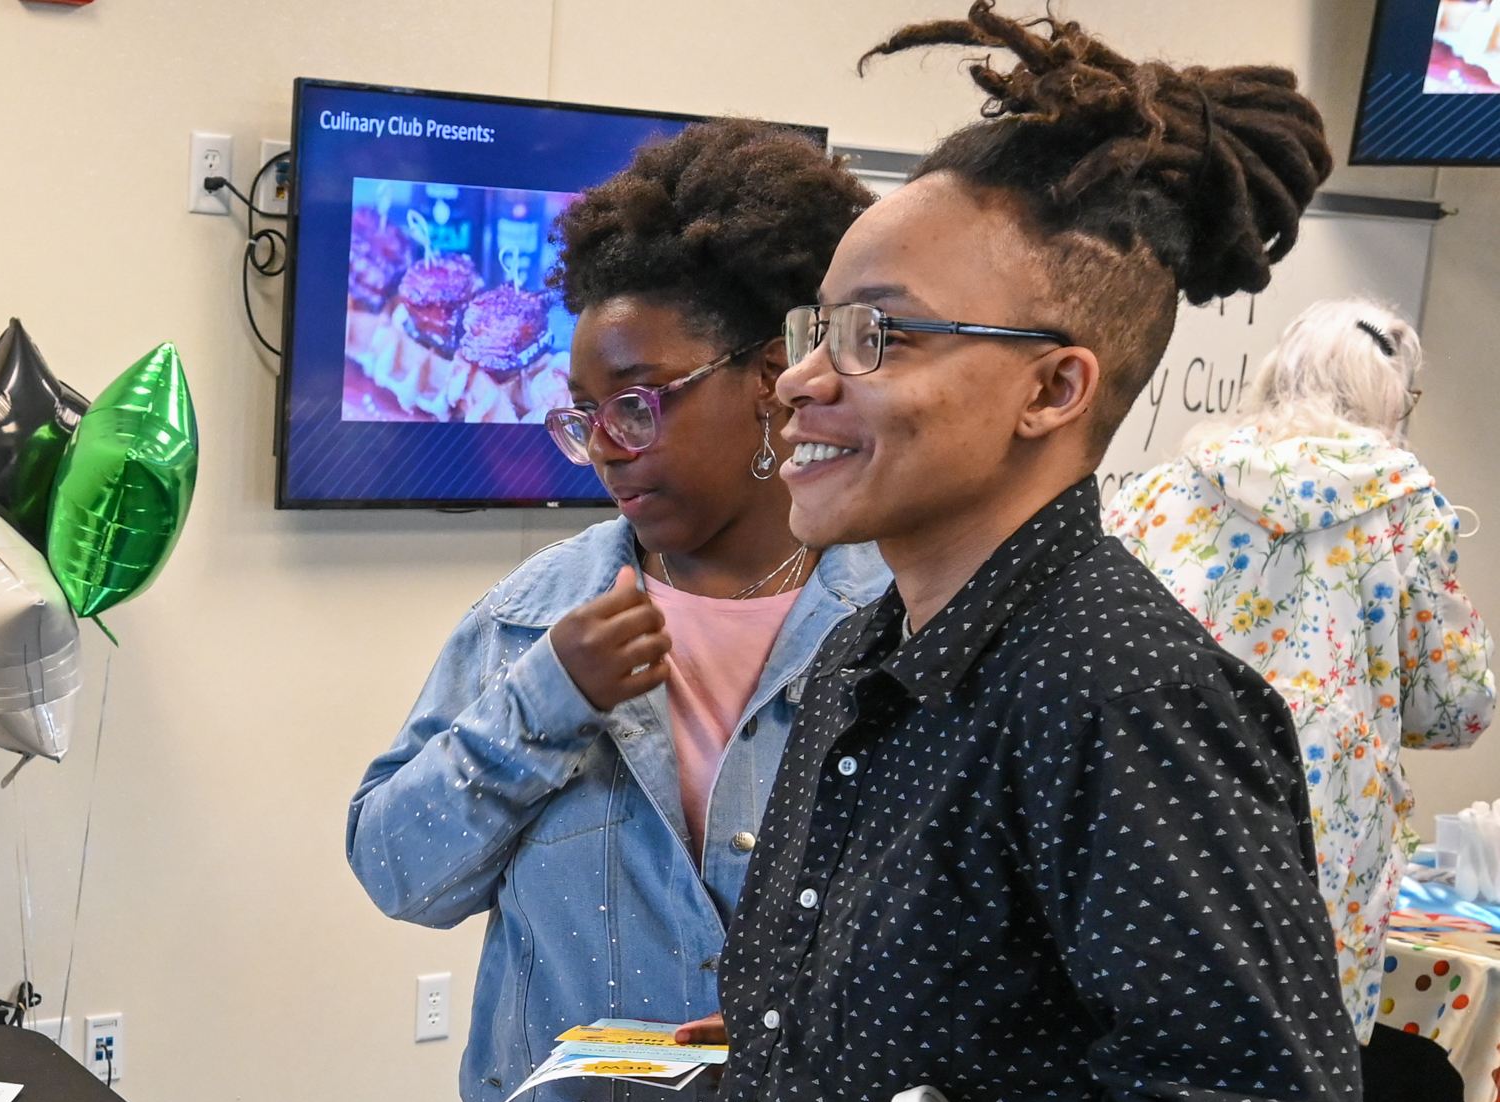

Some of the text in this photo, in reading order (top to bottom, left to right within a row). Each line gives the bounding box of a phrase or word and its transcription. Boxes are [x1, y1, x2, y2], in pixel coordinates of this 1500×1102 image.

[320, 110, 495, 143] Culinary Club Presents:
